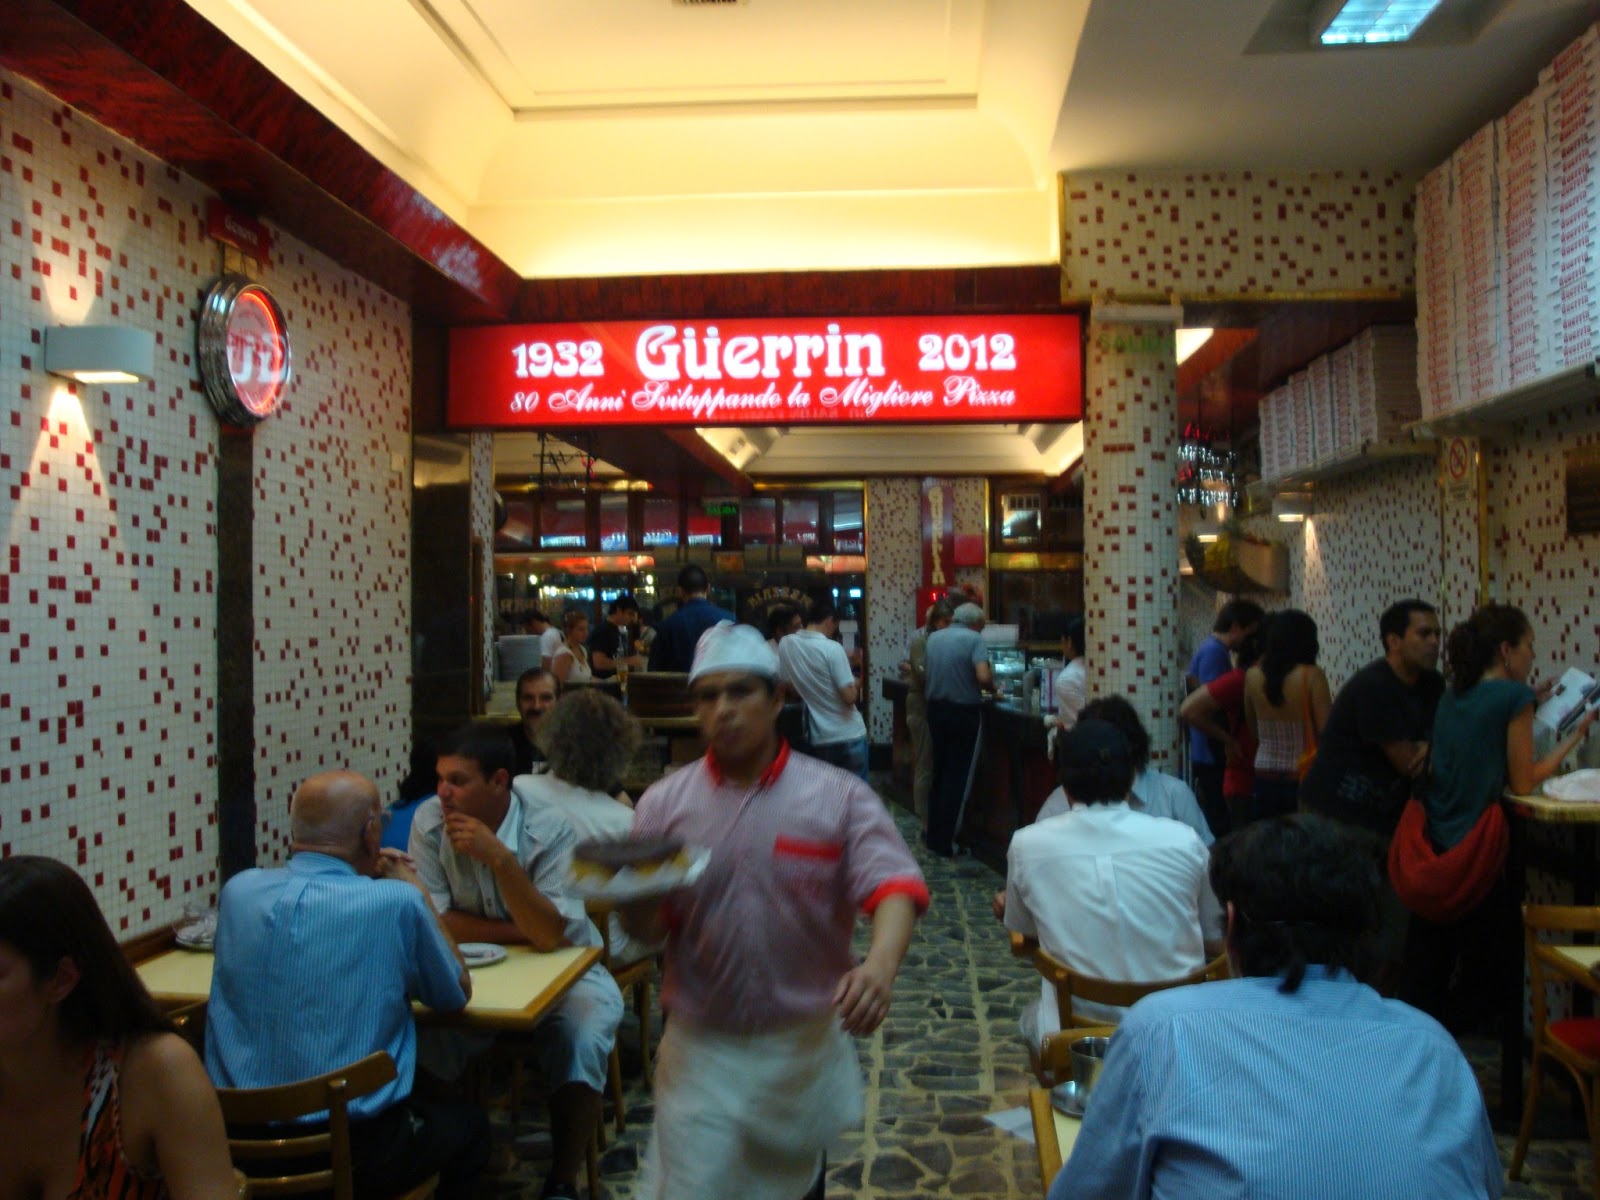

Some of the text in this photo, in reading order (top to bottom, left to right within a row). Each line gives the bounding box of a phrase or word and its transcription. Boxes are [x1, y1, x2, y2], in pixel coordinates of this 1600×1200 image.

[512, 324, 1016, 380] 1932 Güerrin 2012
[510, 392, 538, 412] 80
[786, 385, 811, 409] la
[821, 380, 933, 414] Migliore
[943, 377, 1015, 407] Pizza
[705, 505, 737, 515] SALIDA
